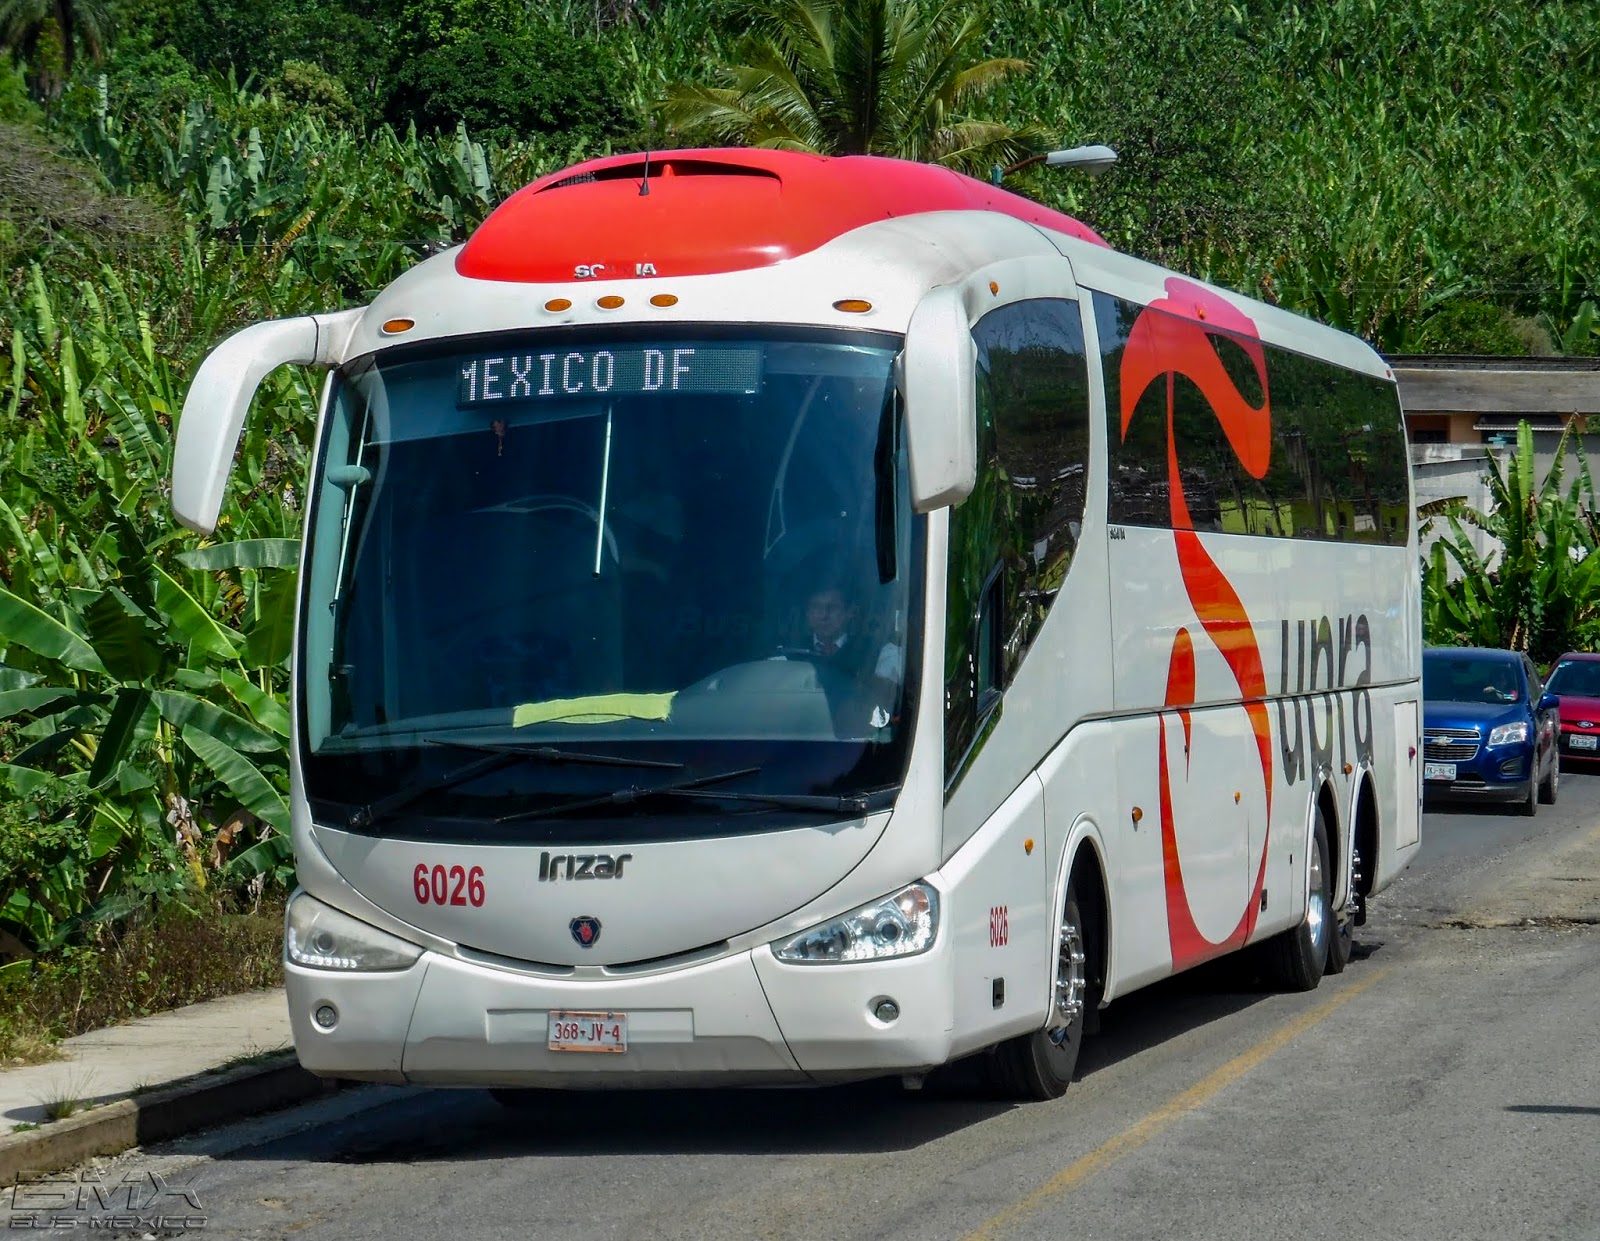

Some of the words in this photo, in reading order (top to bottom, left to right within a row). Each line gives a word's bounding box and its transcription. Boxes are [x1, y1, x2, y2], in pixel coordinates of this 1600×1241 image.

[643, 349, 695, 390] DF
[413, 863, 485, 908] 6026
[538, 851, 633, 882] Irizar
[990, 905, 1008, 948] 6026
